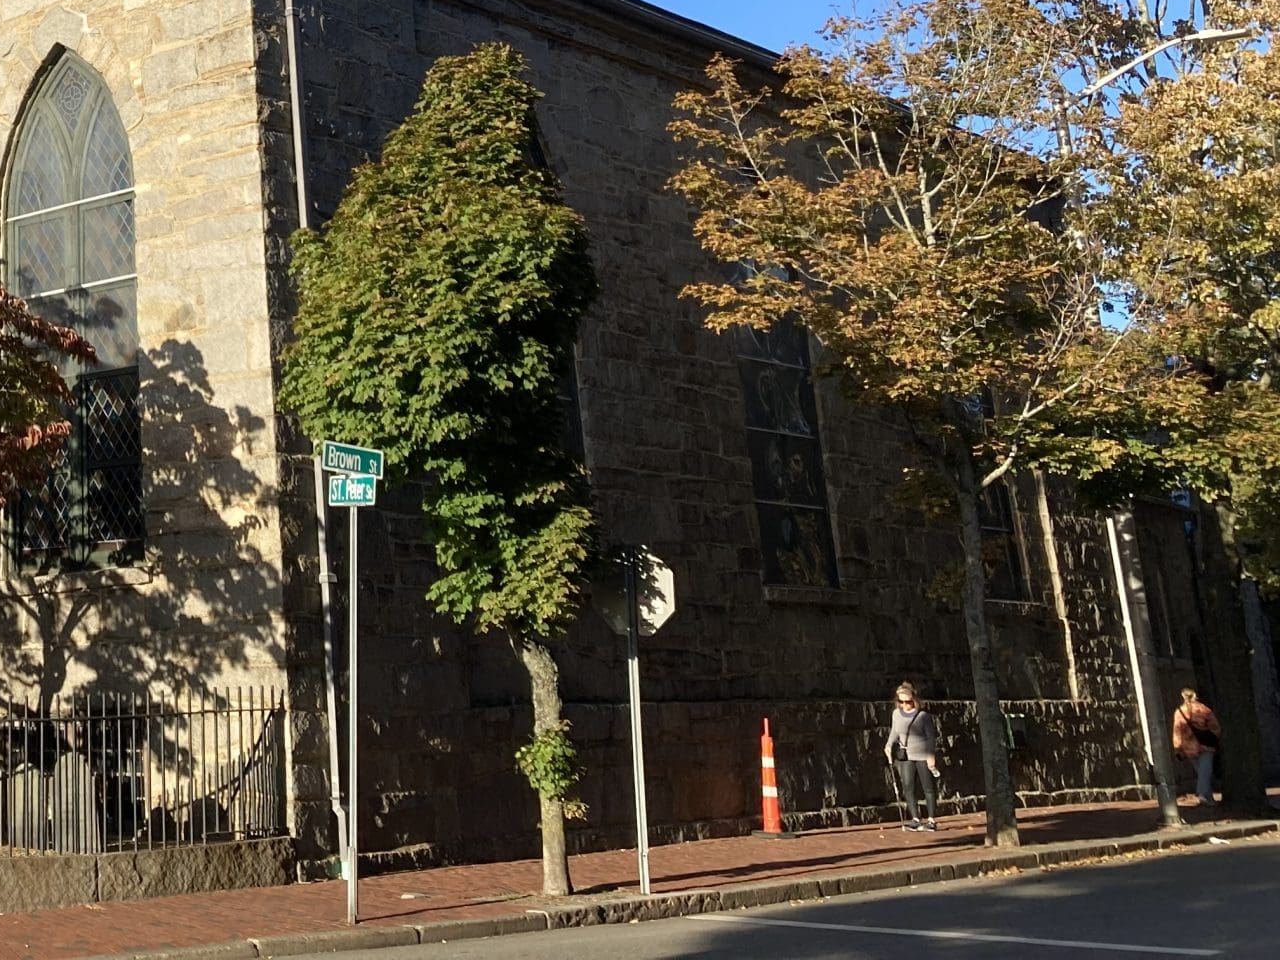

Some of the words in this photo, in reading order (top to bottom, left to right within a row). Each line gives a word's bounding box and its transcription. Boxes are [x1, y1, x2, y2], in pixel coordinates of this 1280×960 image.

[328, 446, 361, 471] Brown
[369, 459, 377, 474] St
[331, 479, 345, 501] ST.
[346, 479, 365, 500] Peter
